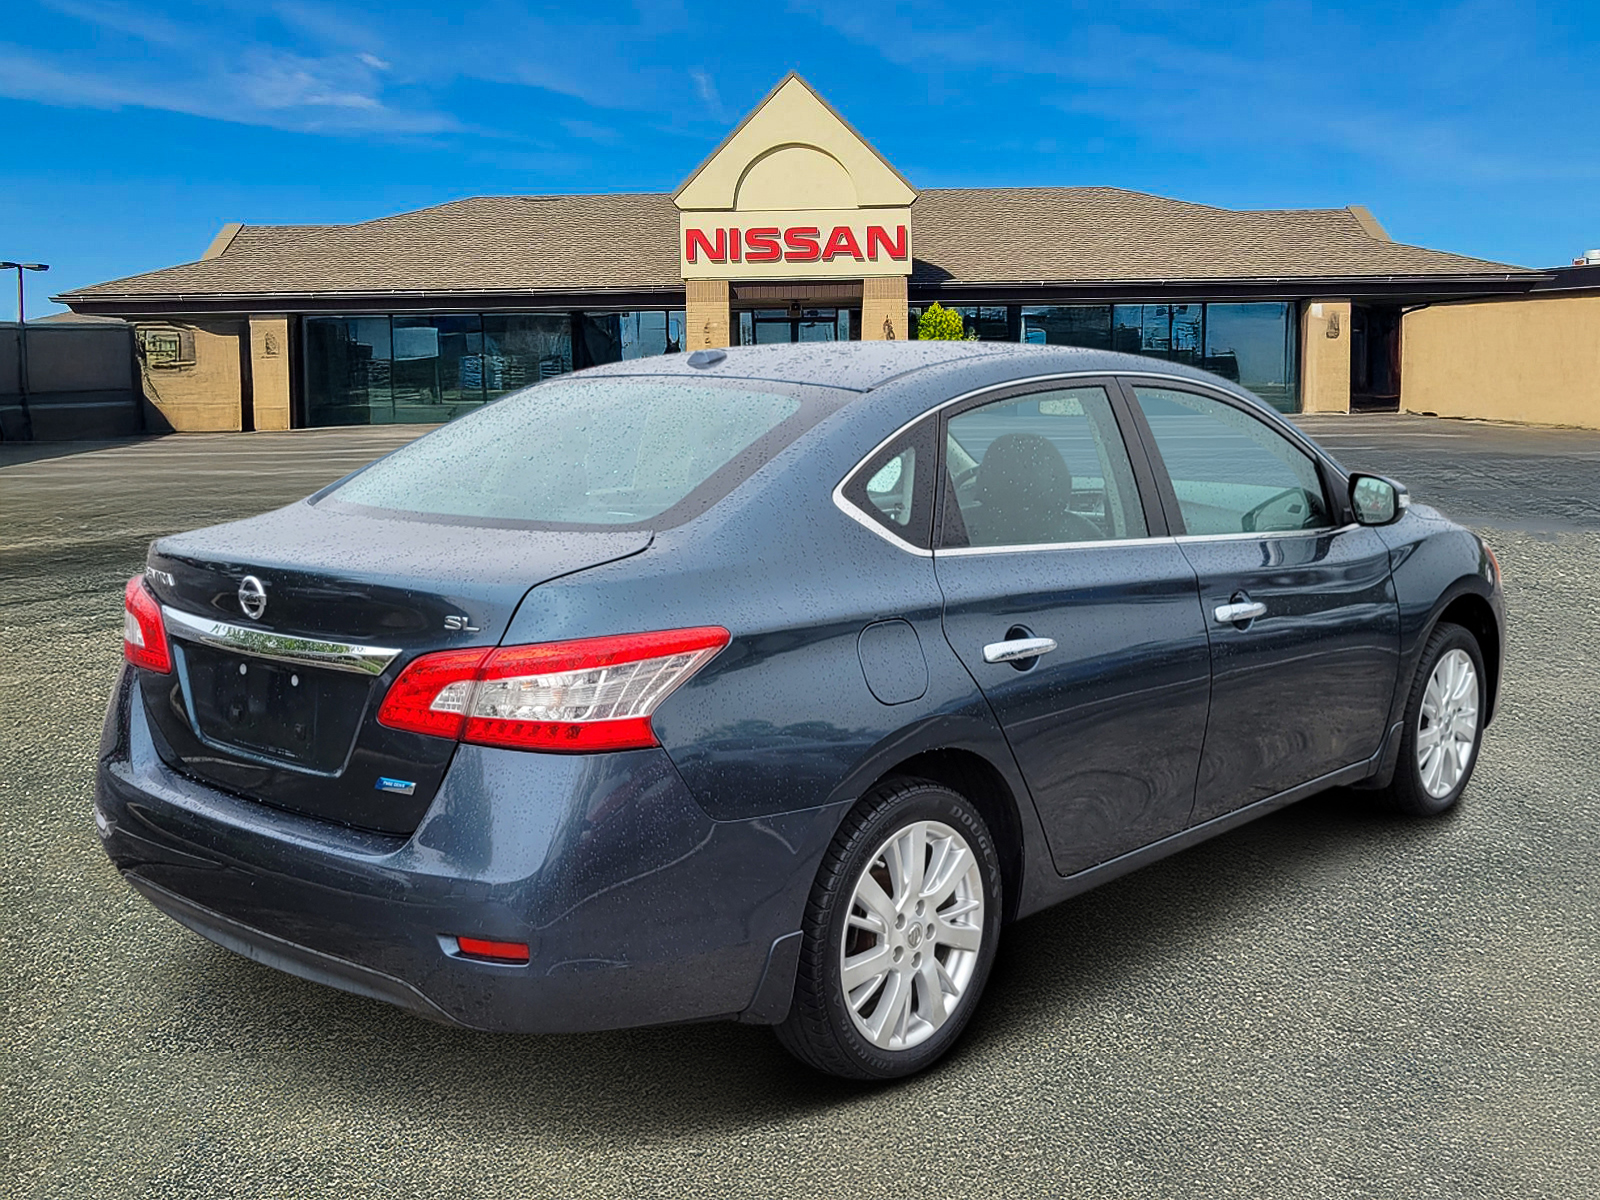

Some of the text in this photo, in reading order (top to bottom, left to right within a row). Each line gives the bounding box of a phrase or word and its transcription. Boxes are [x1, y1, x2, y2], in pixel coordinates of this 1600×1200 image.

[685, 225, 908, 264] NISSAN
[444, 615, 480, 631] SL
[949, 805, 998, 898] DOUGLAS
